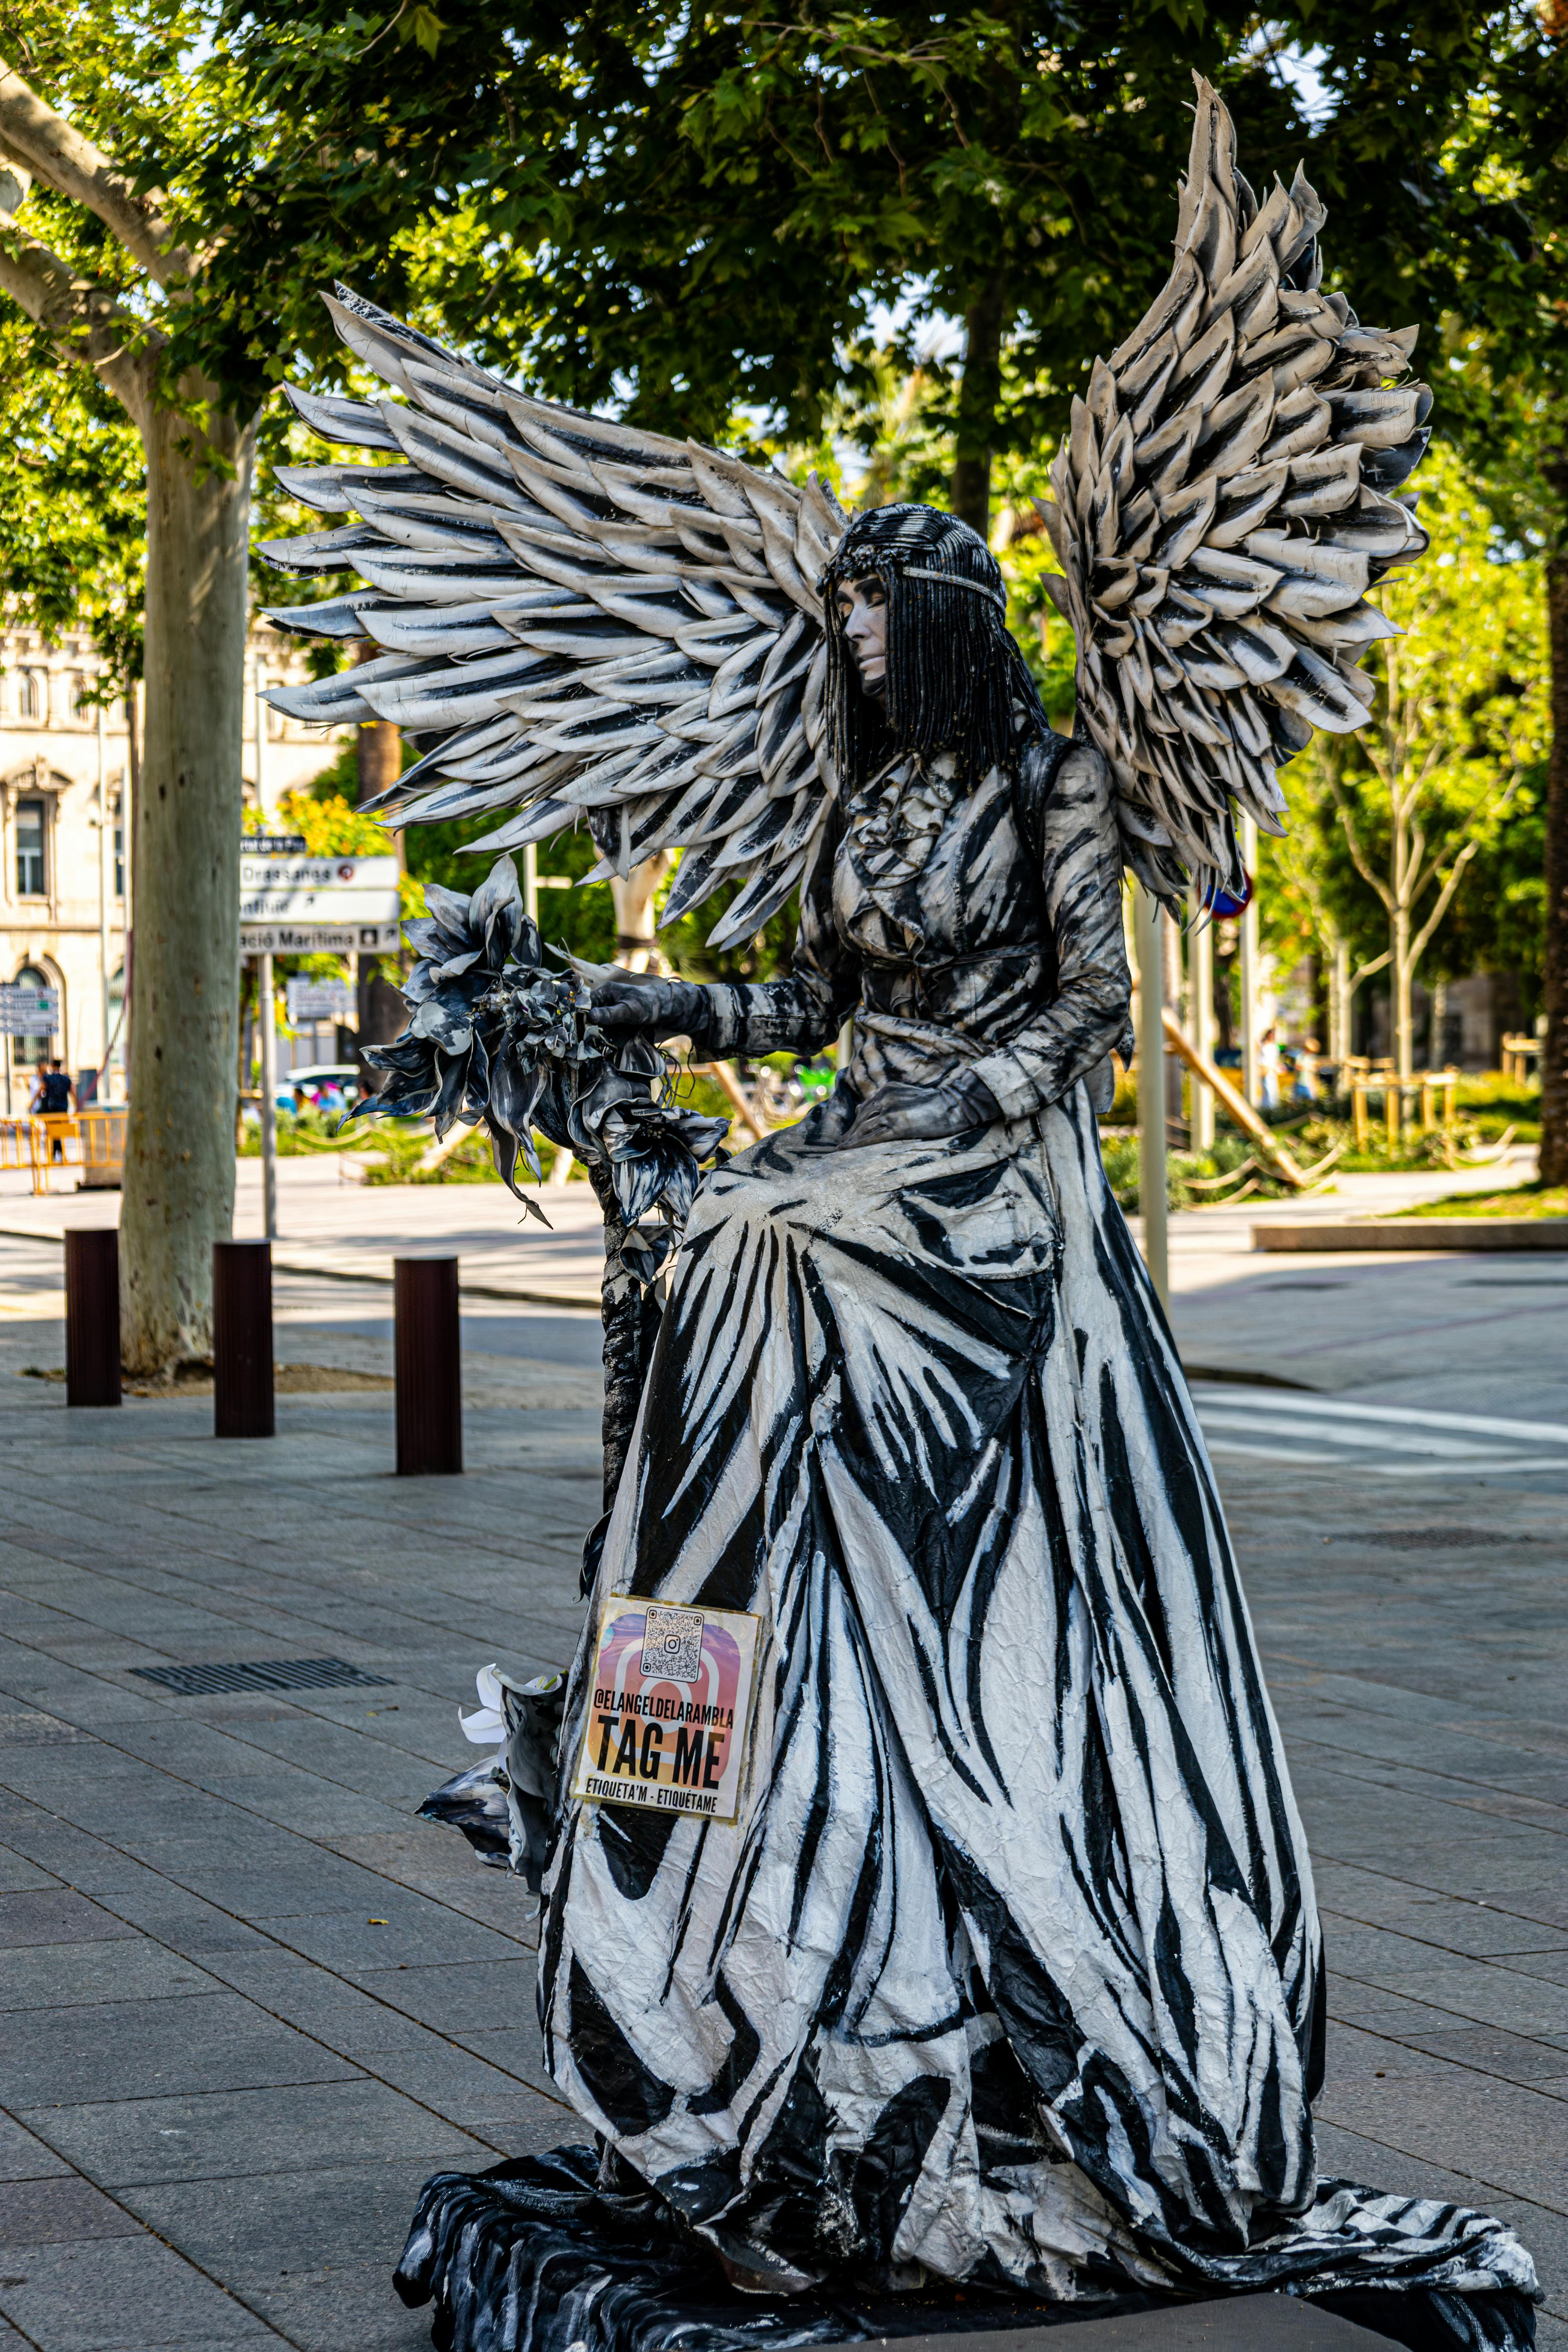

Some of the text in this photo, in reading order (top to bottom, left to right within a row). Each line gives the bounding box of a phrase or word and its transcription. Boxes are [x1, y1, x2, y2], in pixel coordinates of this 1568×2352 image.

[243, 867, 331, 882] Drassanes
[594, 1689, 733, 1729] @ELANGELDELARAMBLA
[597, 1714, 725, 1790] TAG ME
[585, 1778, 648, 1802] ETIQUETA'M
[657, 1788, 718, 1813] ETIQUÉTAME
